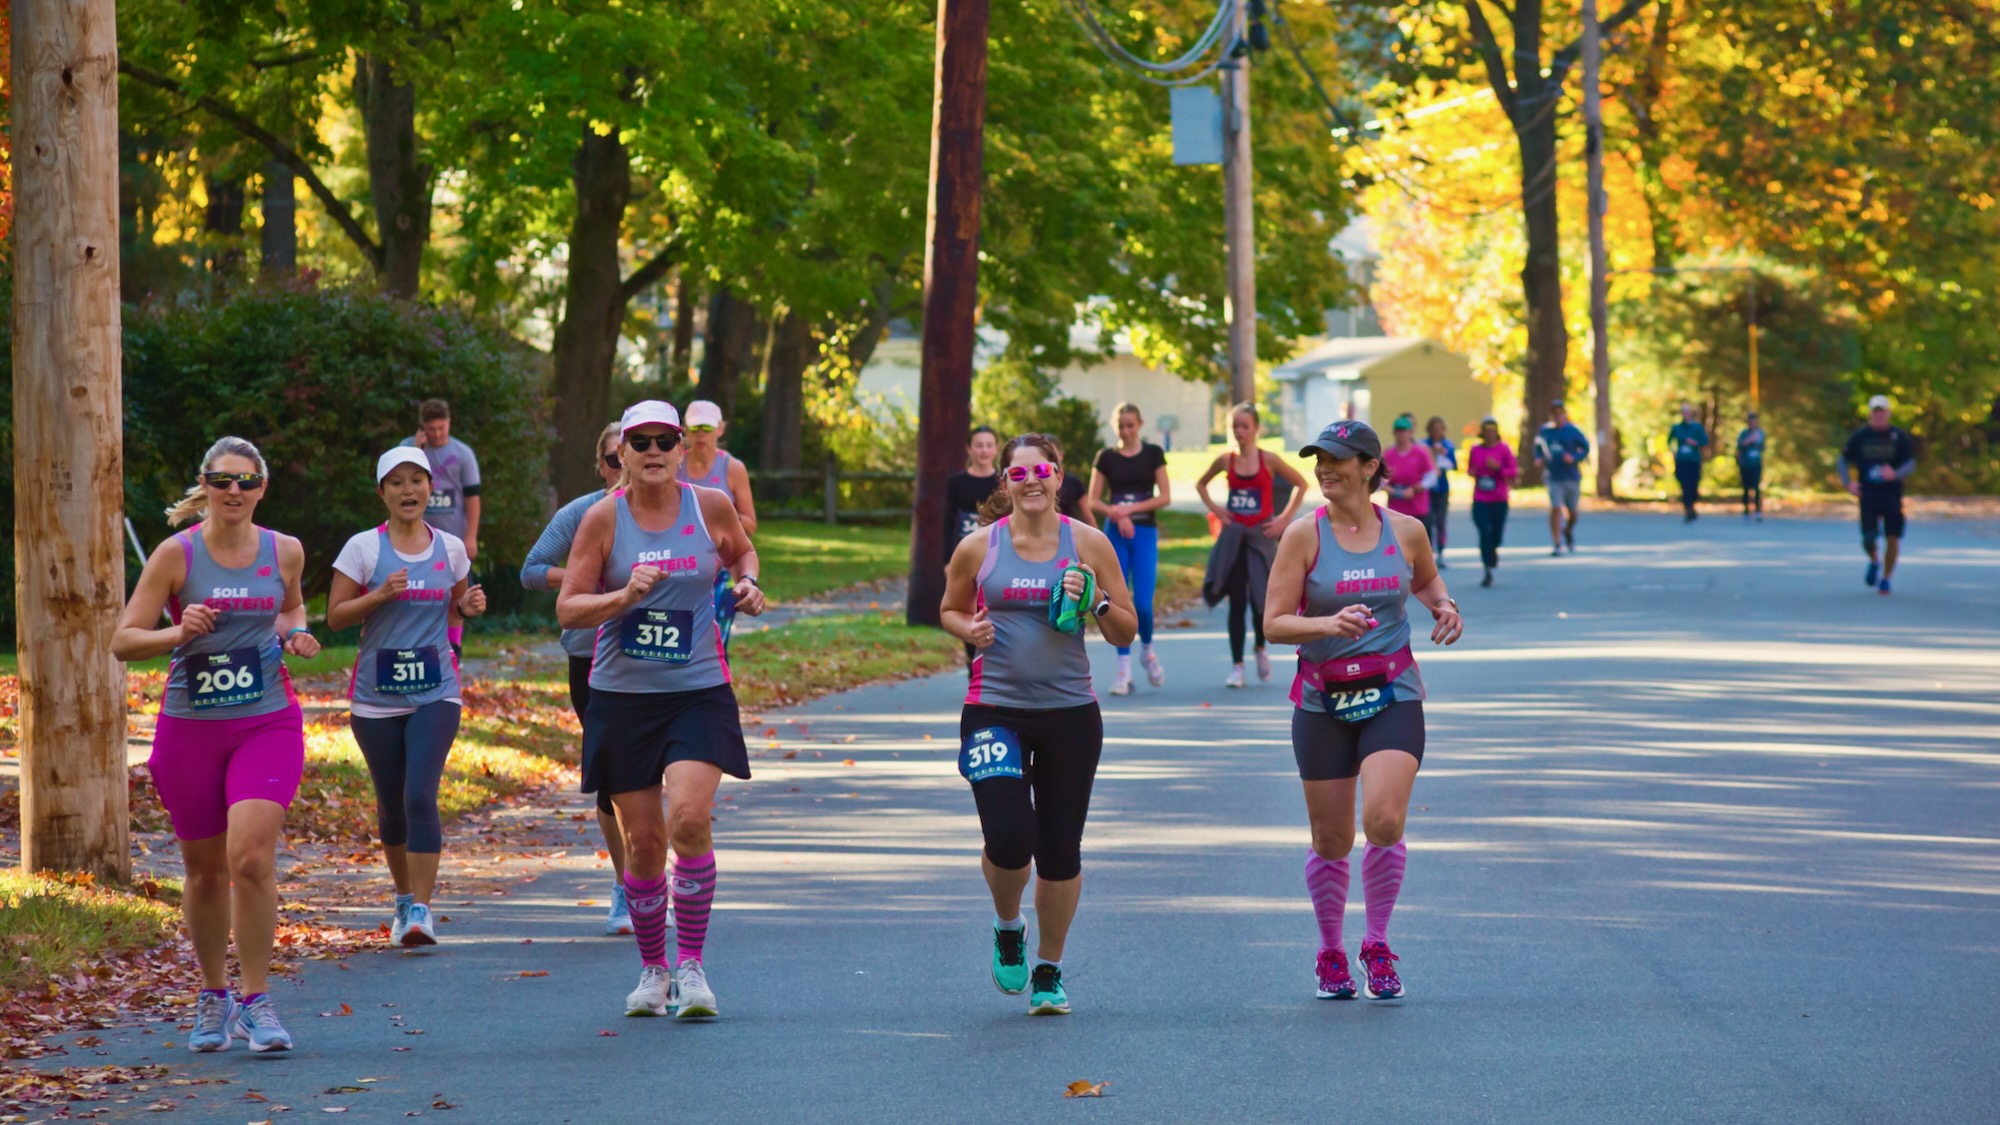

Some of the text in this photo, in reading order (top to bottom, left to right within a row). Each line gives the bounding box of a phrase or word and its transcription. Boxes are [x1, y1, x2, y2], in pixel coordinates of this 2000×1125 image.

[1231, 496, 1257, 508] 376
[638, 549, 671, 563] SOLE
[1011, 578, 1047, 588] SOLE
[1343, 568, 1375, 581] SOLE
[212, 587, 249, 598] SOLE
[1336, 575, 1400, 596] SISTERS
[635, 623, 680, 648] 312
[196, 665, 254, 694] 206
[392, 661, 425, 682] 311
[1331, 688, 1381, 711] 225
[968, 741, 1008, 769] 319
